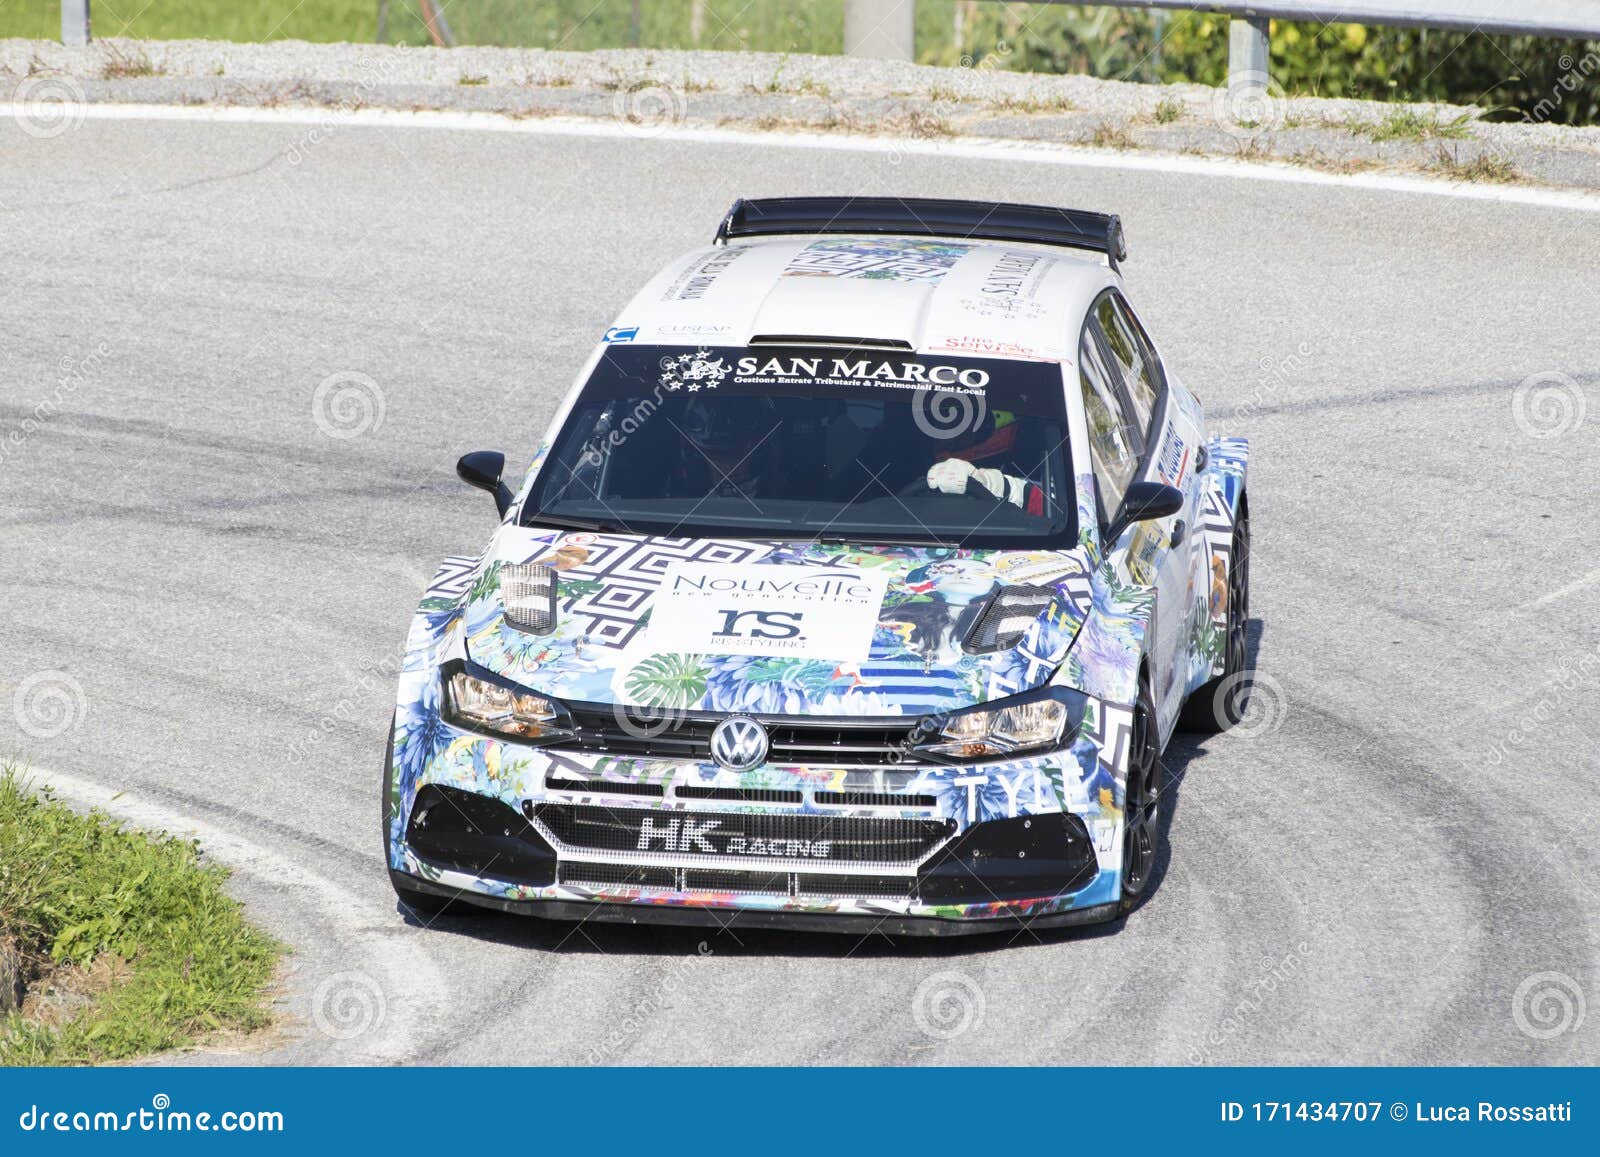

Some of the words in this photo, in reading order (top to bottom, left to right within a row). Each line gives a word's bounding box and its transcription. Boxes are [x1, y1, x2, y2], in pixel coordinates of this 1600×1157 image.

[733, 376, 776, 384] Gestione
[777, 377, 812, 385] Entrate
[814, 377, 861, 386] Tributarie
[956, 387, 986, 396] Locali
[735, 357, 822, 377] SAN
[832, 359, 990, 388] MARCO
[674, 574, 872, 598] Nouvelle
[637, 817, 722, 852] HK
[726, 838, 830, 857] RACING
